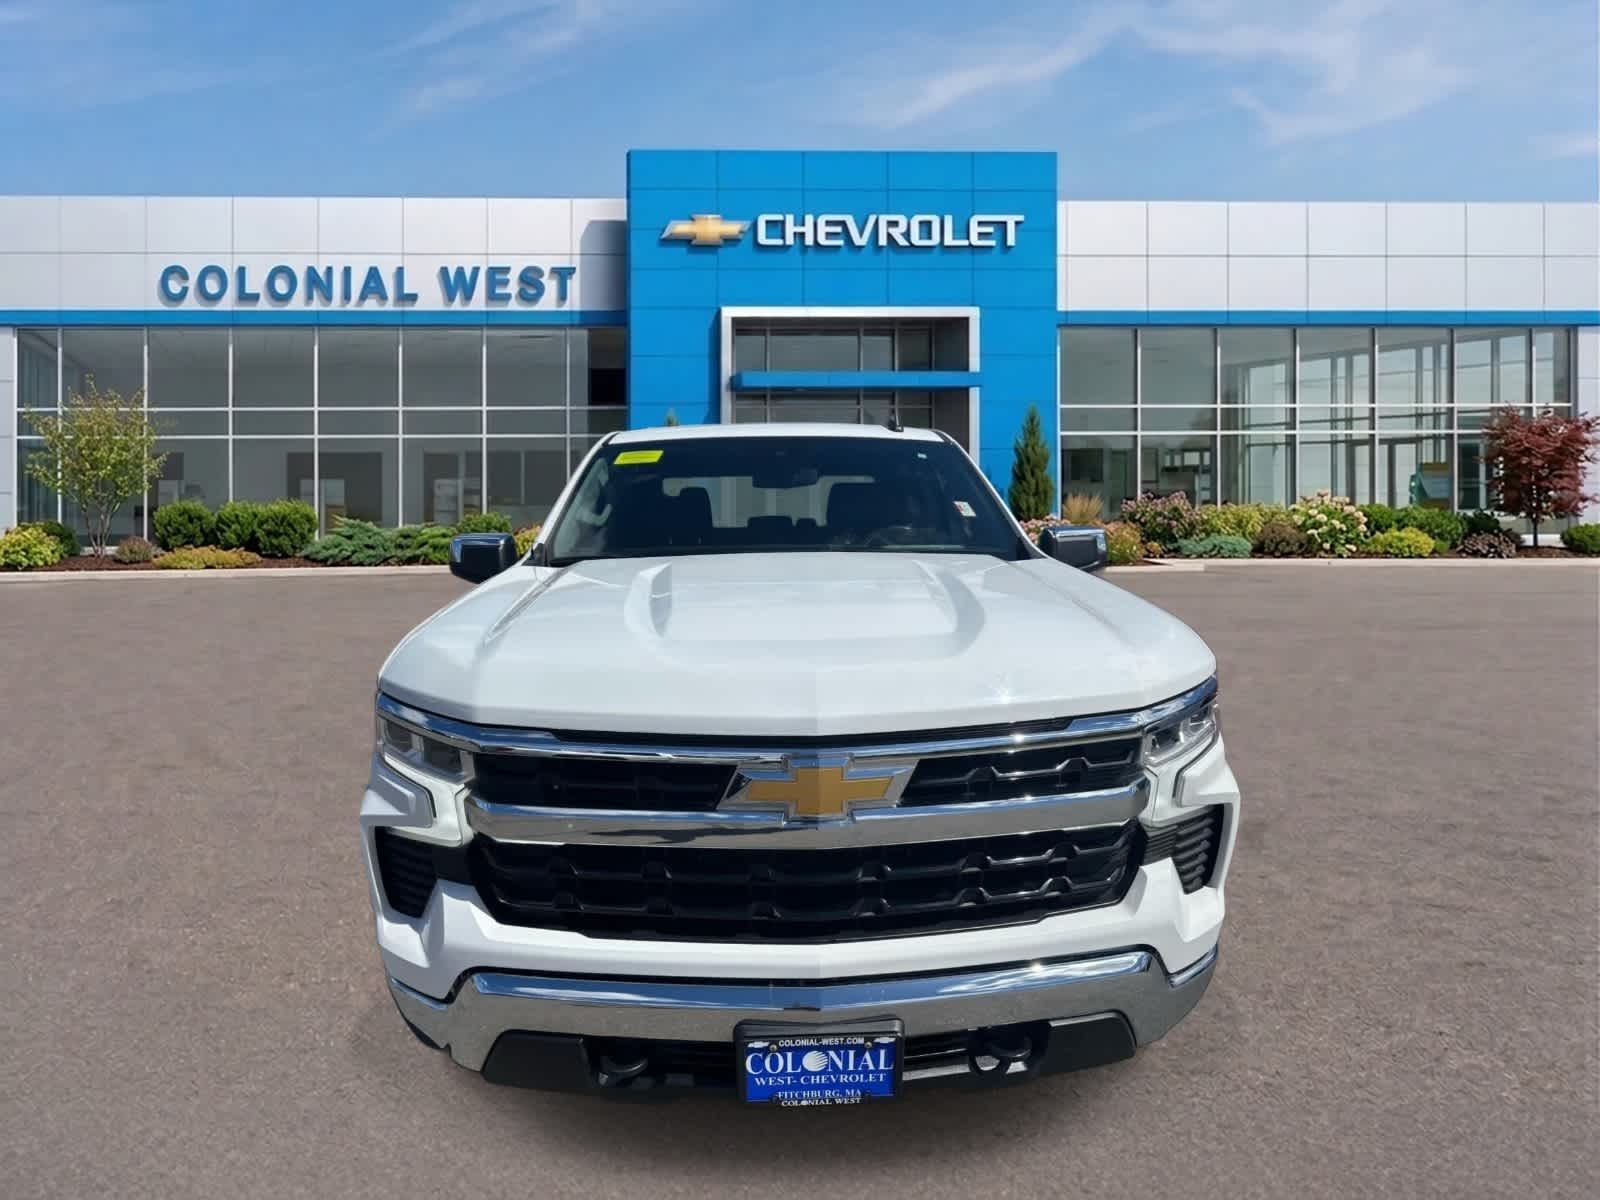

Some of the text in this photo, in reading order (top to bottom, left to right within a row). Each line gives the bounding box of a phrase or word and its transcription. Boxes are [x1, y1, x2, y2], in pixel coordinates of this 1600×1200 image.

[757, 214, 1025, 247] CHEVROLET
[160, 265, 577, 304] COLONIAL WEST
[778, 1037, 865, 1048] COLONIAL-WEST.COM
[745, 1049, 895, 1075] COLONIAL
[800, 1073, 887, 1085] CHEVROLET
[845, 1089, 862, 1097] MA
[781, 1097, 862, 1107] COLONIAL WEST
